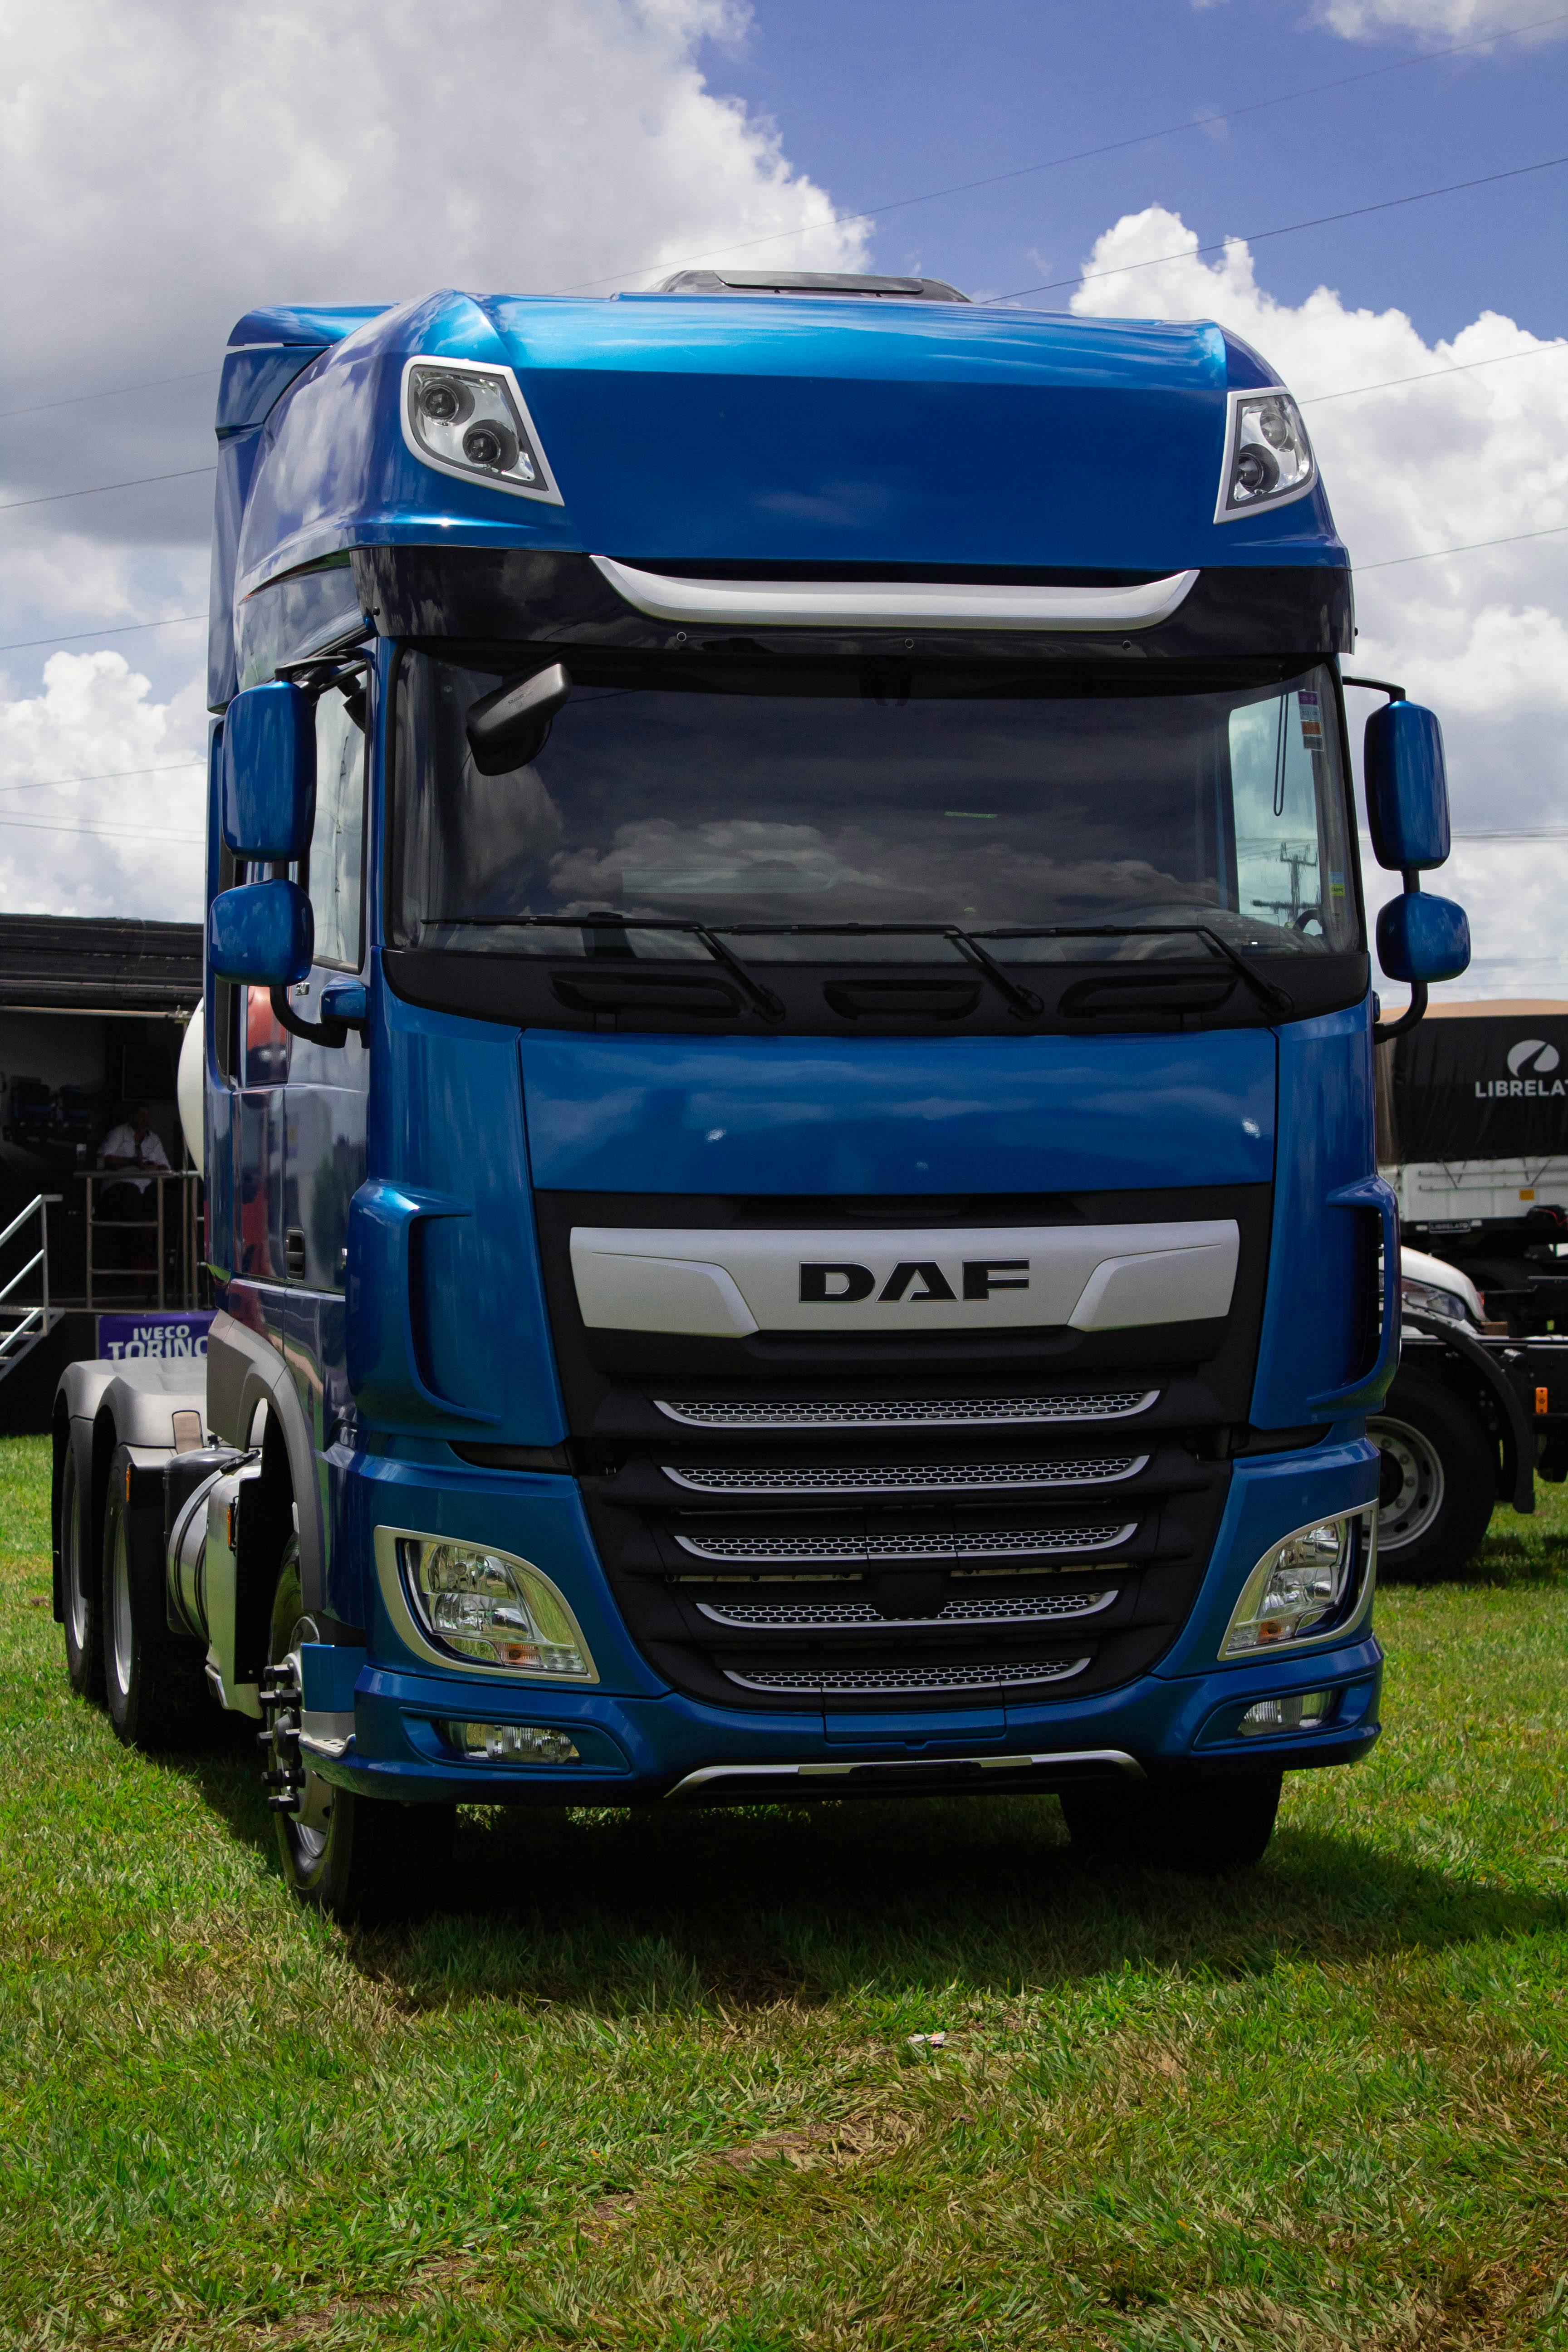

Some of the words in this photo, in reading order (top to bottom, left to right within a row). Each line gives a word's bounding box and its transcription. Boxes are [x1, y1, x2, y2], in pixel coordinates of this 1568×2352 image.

[1475, 1079, 1568, 1098] LIBRELA
[799, 1258, 1029, 1303] DAF
[133, 1325, 190, 1341] IVECO
